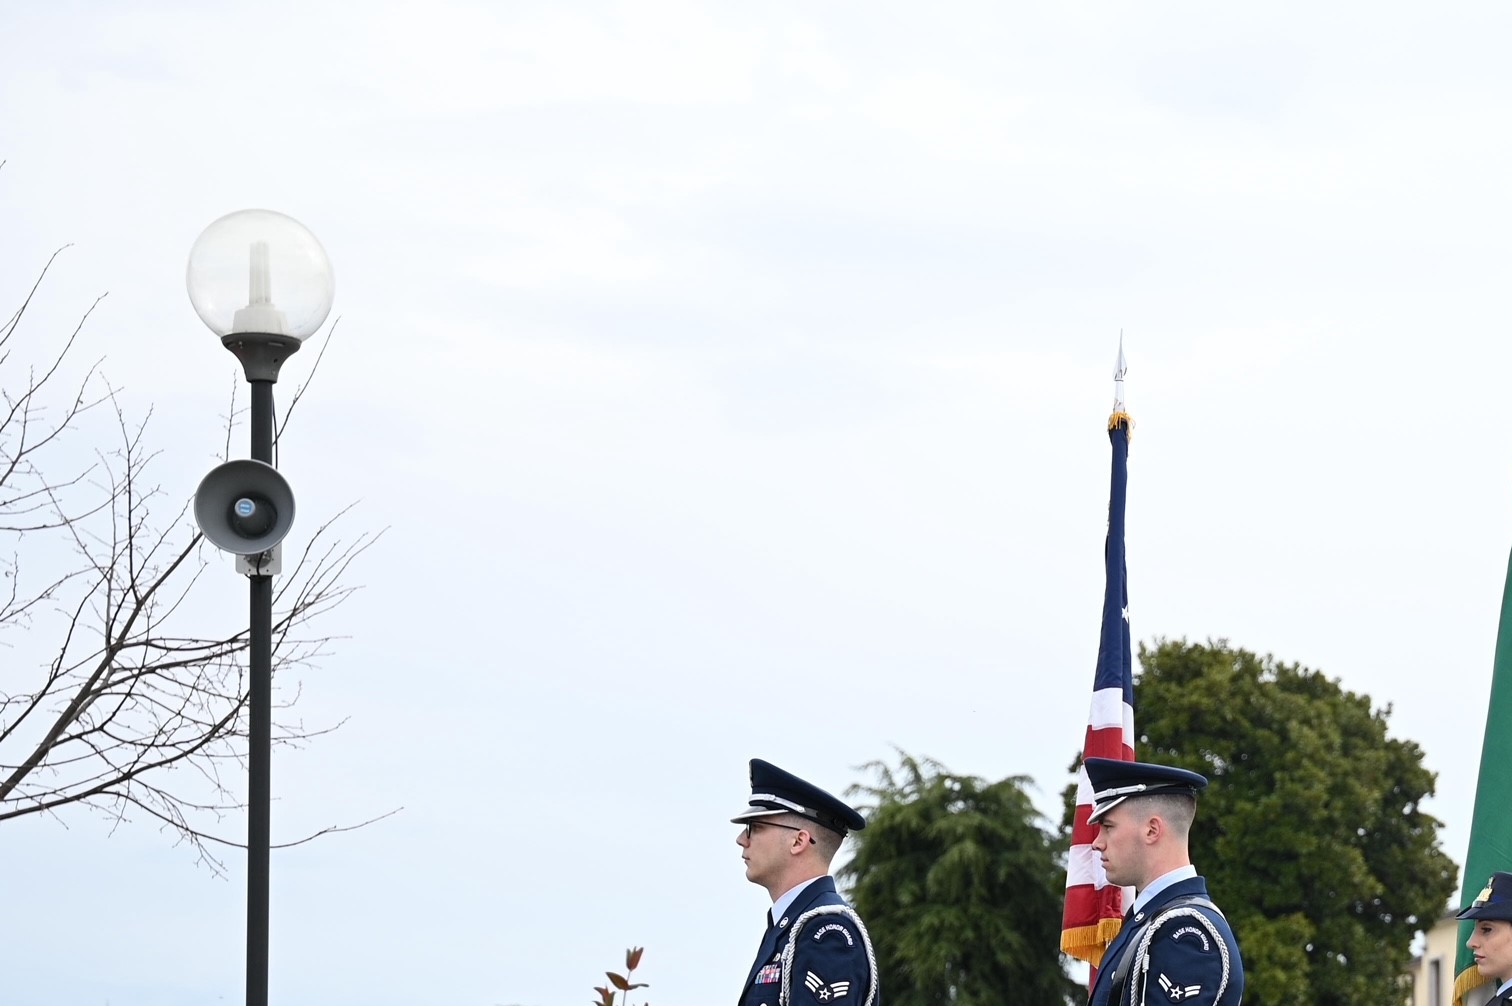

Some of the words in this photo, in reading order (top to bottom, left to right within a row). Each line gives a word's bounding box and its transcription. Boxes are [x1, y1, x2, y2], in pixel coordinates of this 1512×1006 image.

[814, 927, 826, 939] BASE
[842, 929, 853, 946] GUARD
[1173, 928, 1185, 939] BASE
[1185, 926, 1202, 936] HONOR
[1200, 933, 1209, 951] GUARD
